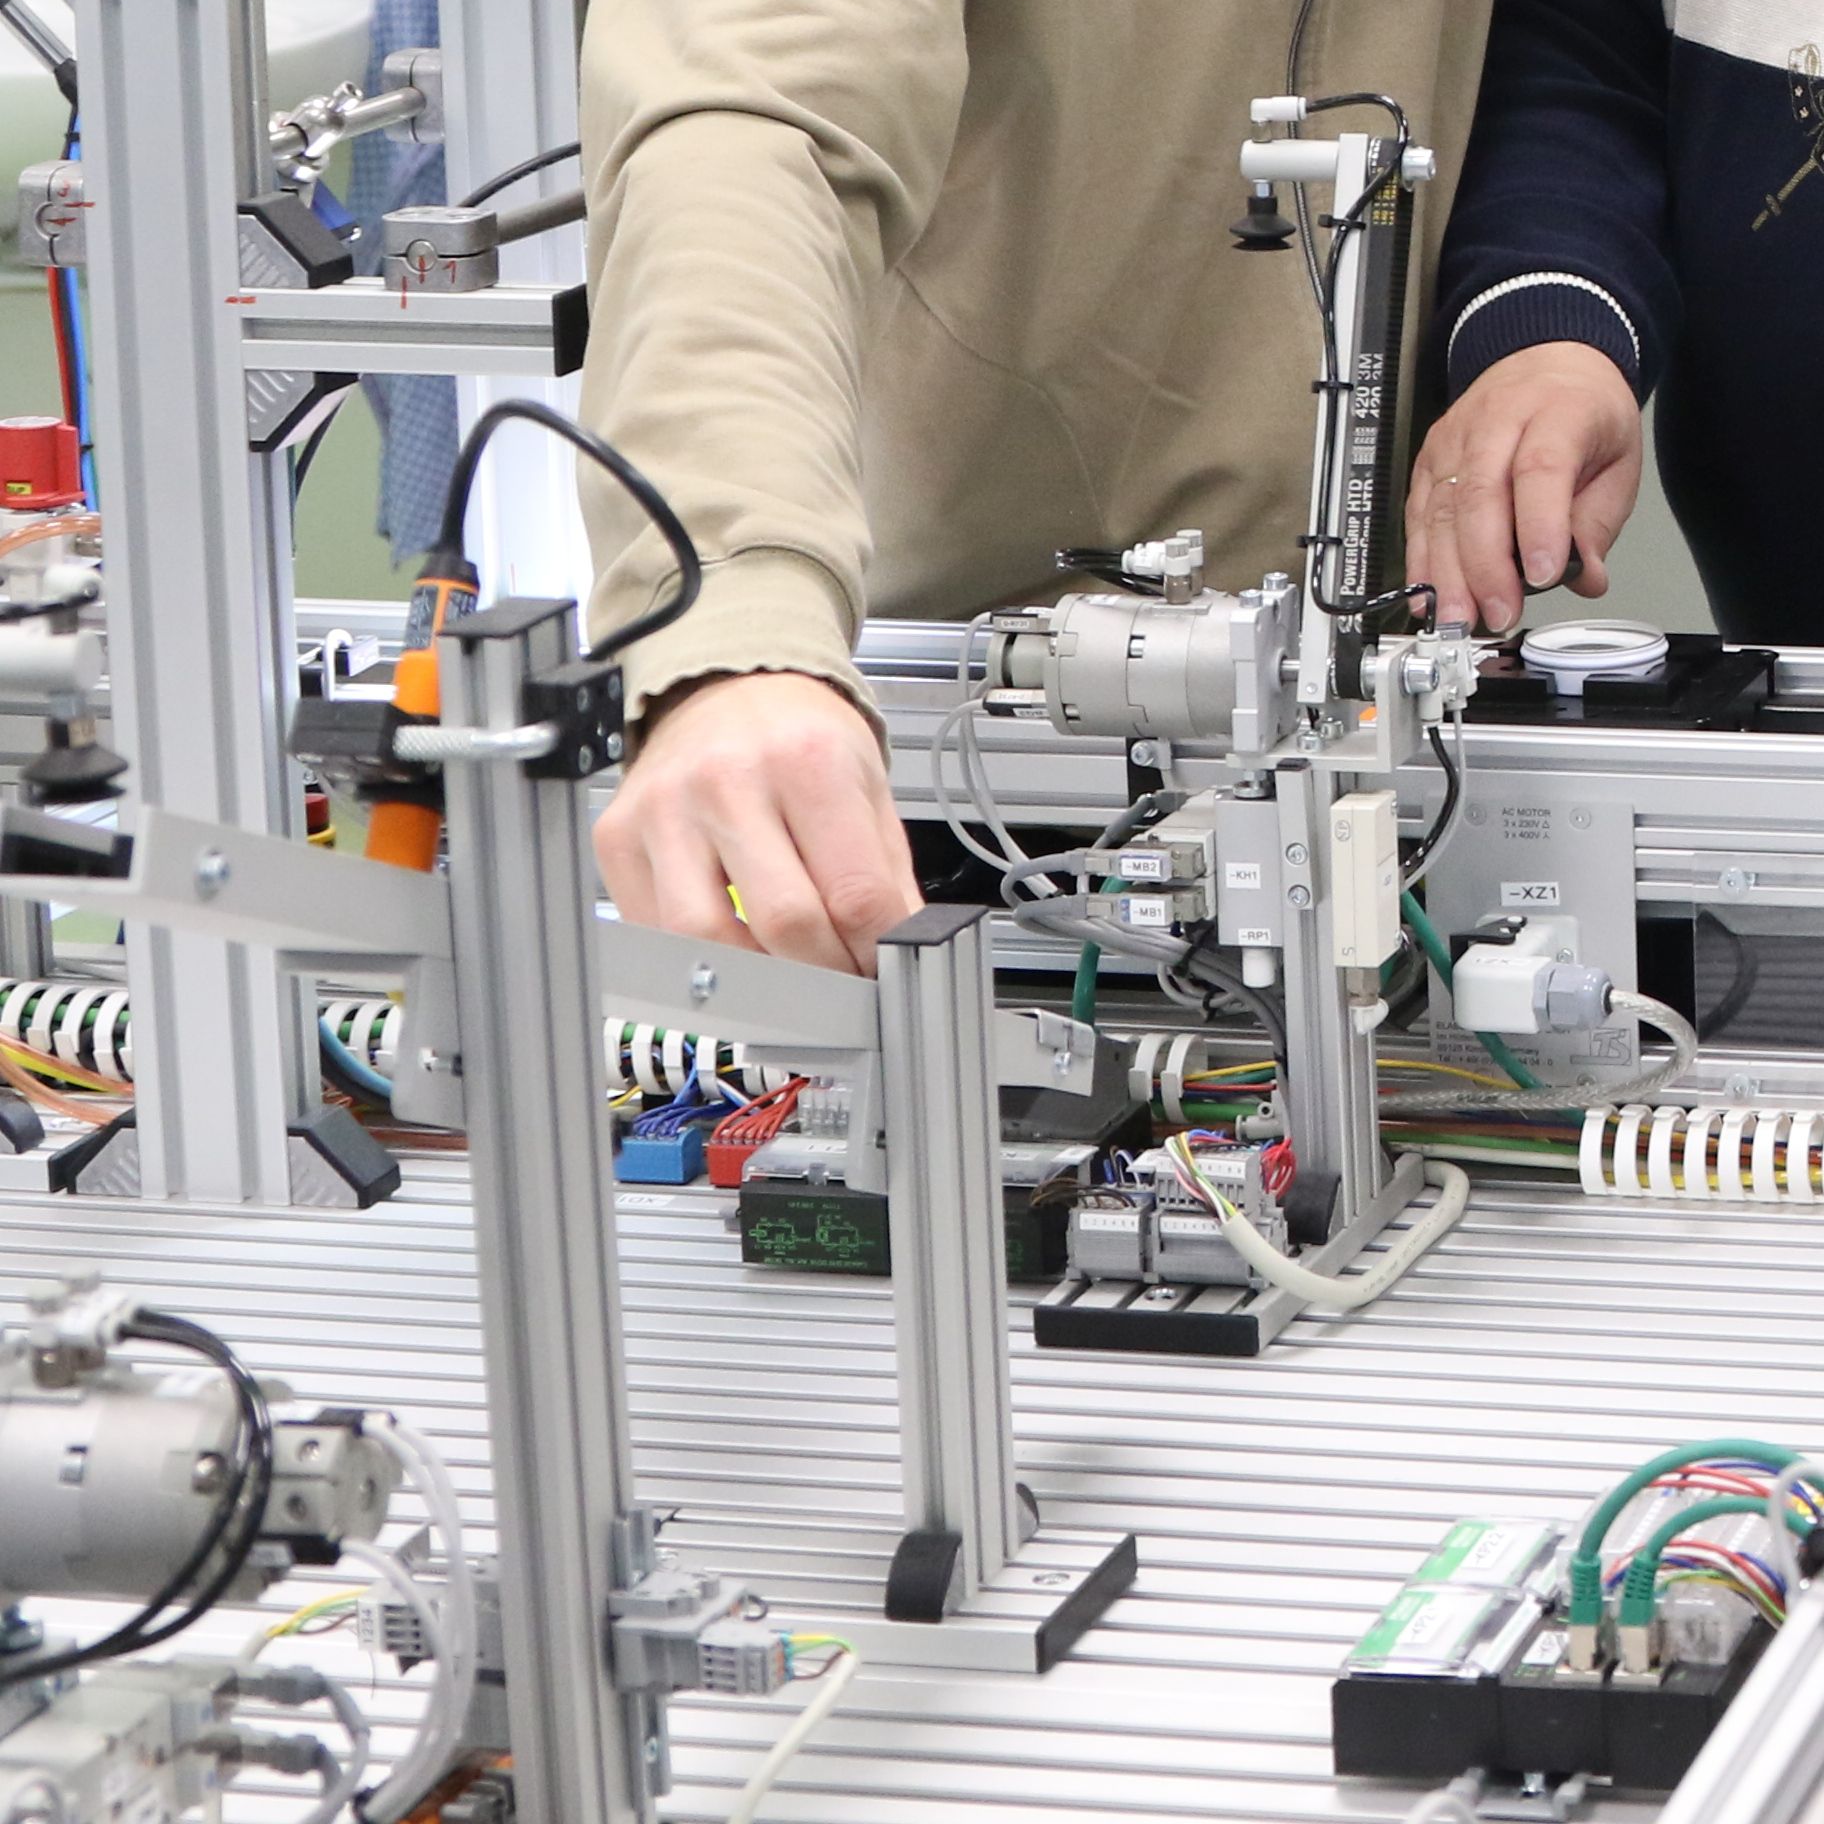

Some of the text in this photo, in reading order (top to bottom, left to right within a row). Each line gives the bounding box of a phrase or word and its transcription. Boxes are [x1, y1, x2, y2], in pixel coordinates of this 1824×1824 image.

[1358, 353, 1373, 381] 3M
[1355, 386, 1370, 419] 420
[1346, 478, 1363, 512] HTD
[1502, 807, 1551, 817] AC MOTOR
[1126, 861, 1158, 873] -MB2
[1229, 869, 1258, 881] -KH1
[1508, 885, 1558, 900] -XZ1
[1132, 906, 1163, 919] -MB1
[1240, 930, 1270, 942] -RP1
